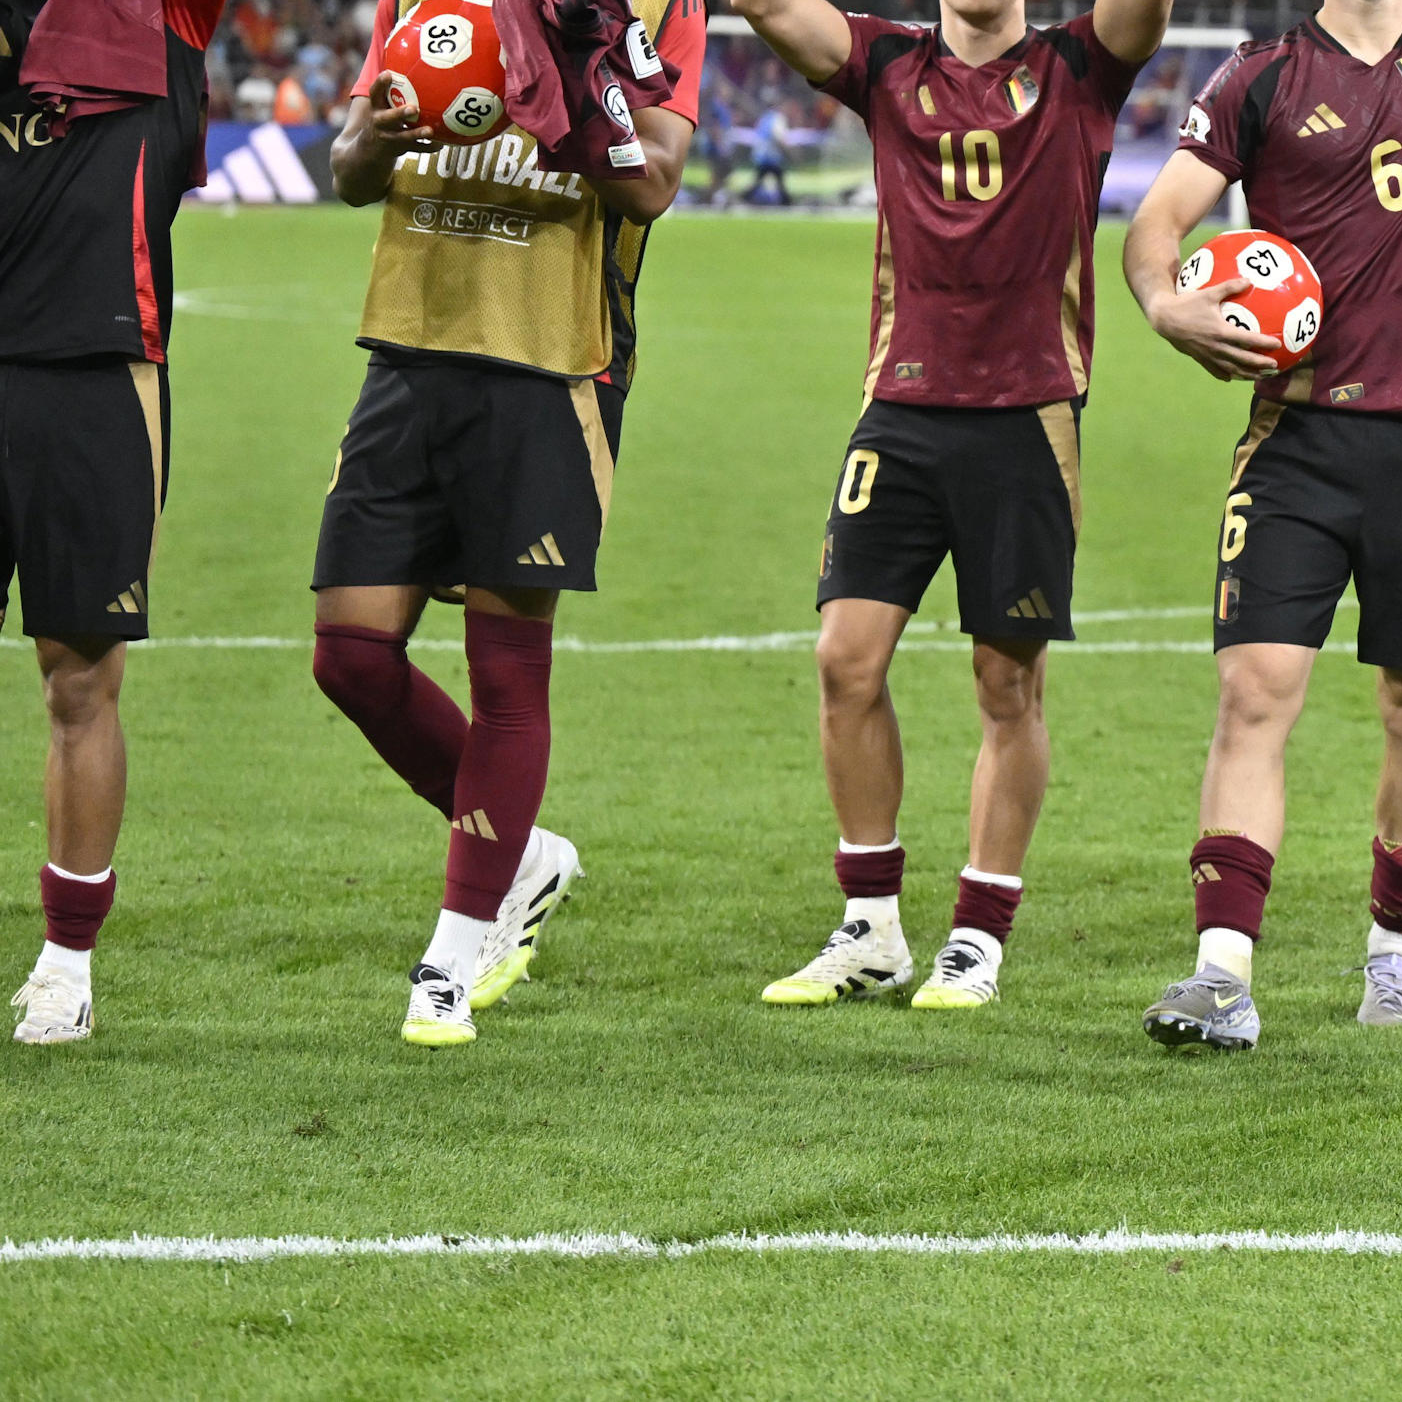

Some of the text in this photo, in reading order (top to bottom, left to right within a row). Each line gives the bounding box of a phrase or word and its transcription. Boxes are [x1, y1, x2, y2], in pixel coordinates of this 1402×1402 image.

[940, 130, 1003, 201] 10
[441, 207, 533, 239] RESPECT
[1295, 311, 1317, 343] 43
[1221, 492, 1253, 563] 6
